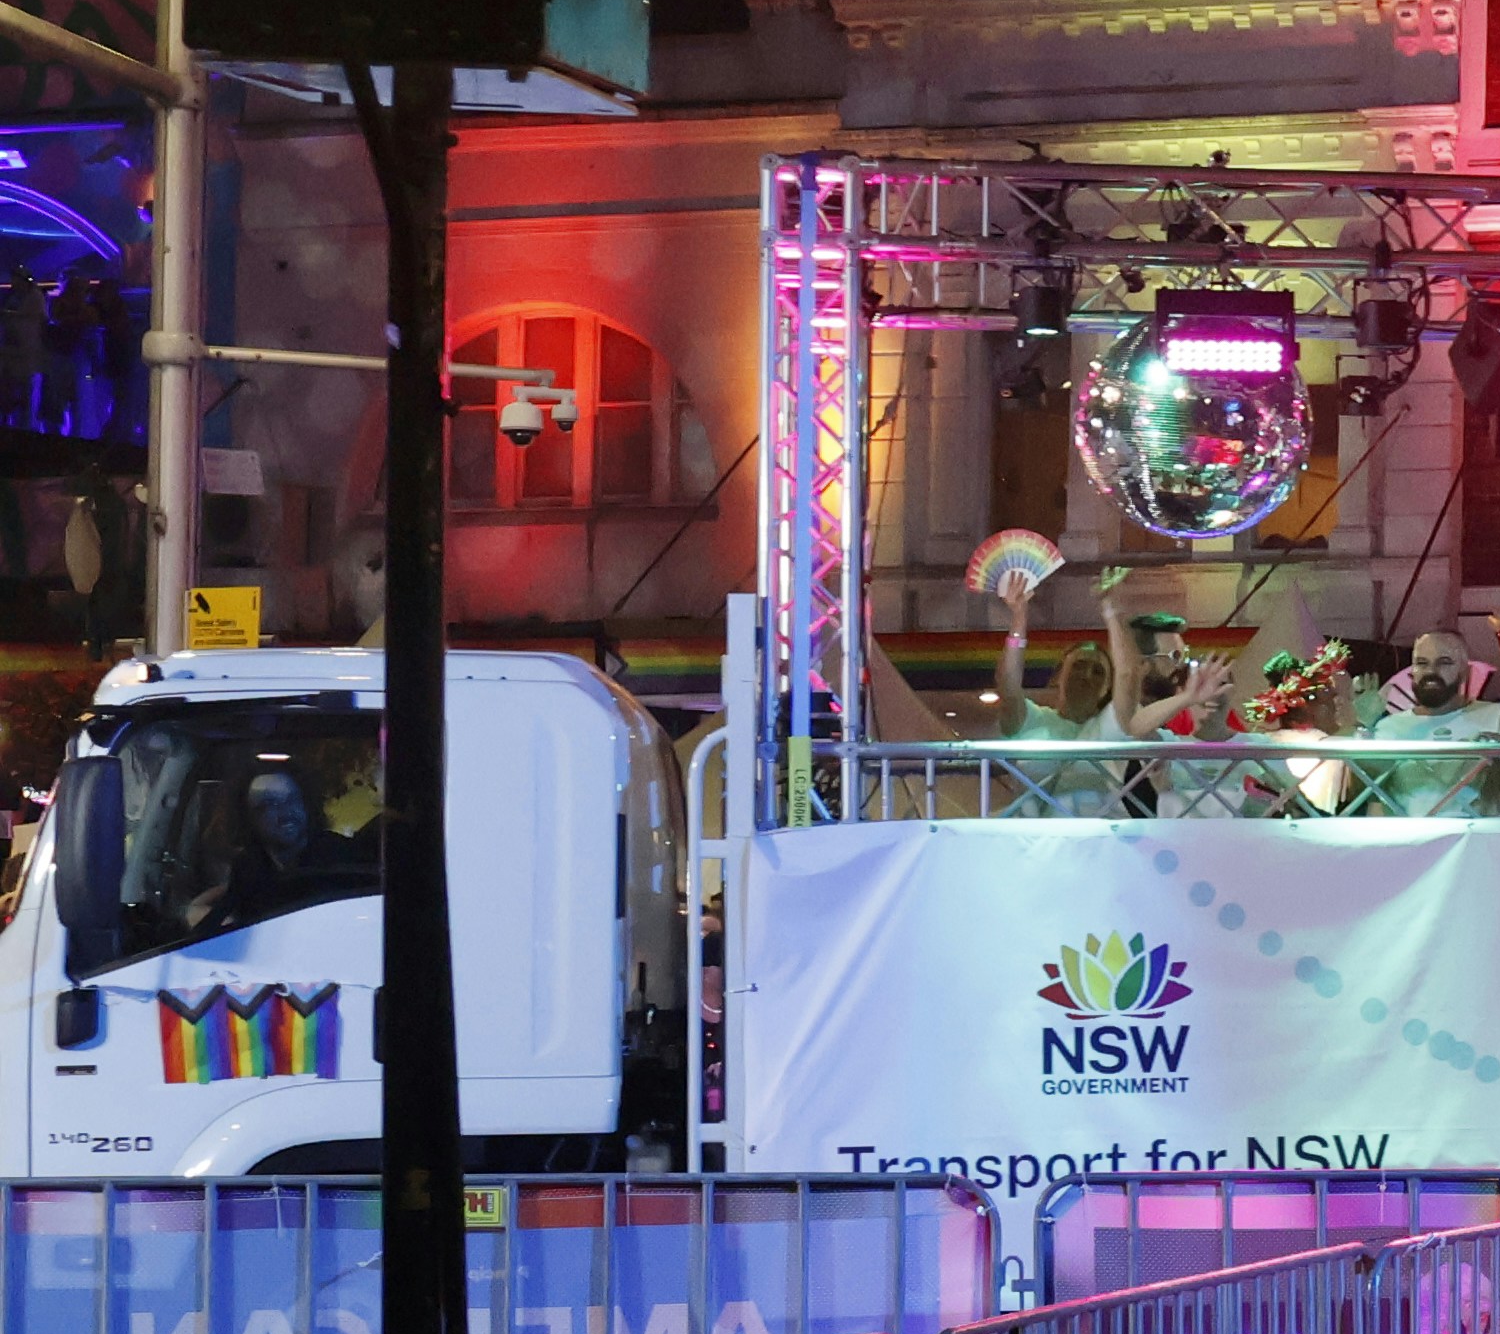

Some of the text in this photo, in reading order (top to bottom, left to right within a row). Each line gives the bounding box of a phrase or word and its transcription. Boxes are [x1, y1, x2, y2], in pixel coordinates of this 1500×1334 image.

[1042, 1024, 1191, 1075] NSW
[1042, 1077, 1190, 1096] GOVERNMENT
[91, 1136, 153, 1153] 260
[837, 1133, 1391, 1197] Transport for NSW
